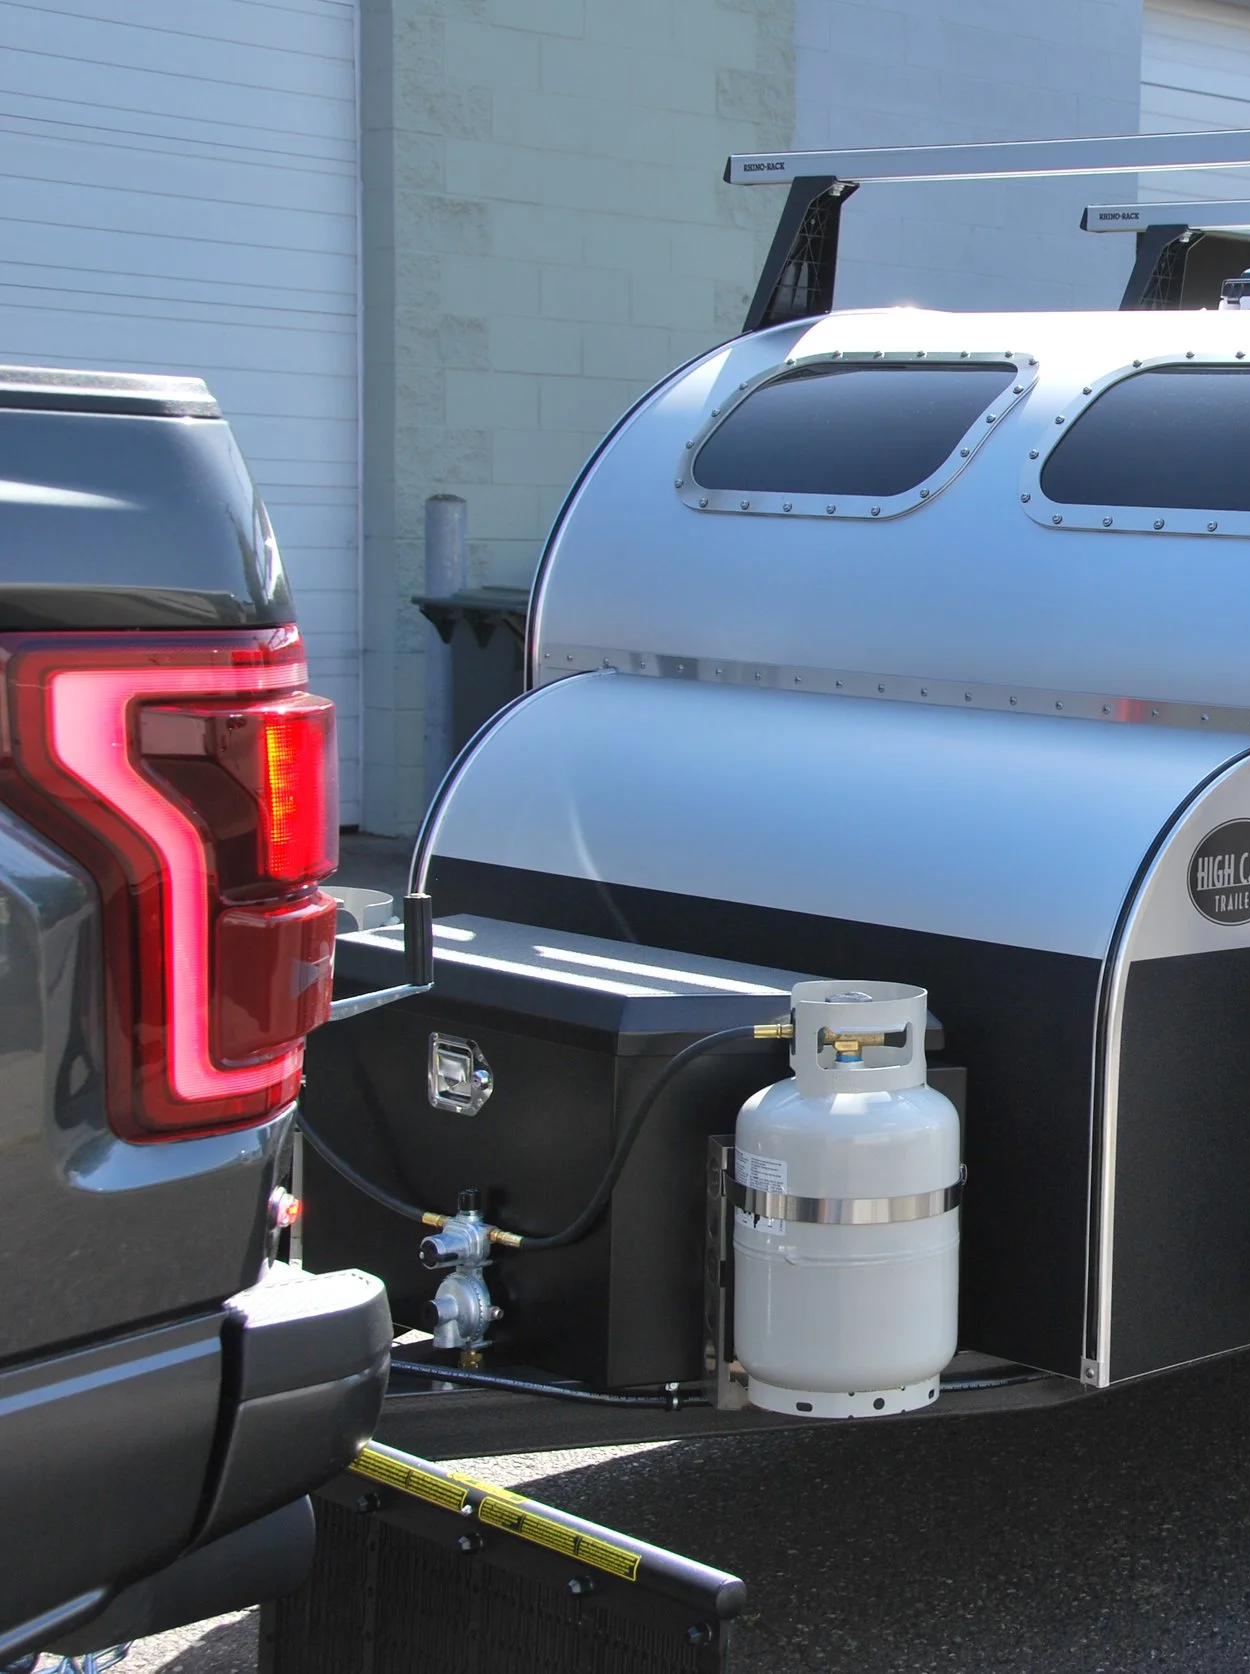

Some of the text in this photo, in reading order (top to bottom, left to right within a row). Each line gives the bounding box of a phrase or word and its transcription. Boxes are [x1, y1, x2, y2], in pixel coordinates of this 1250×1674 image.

[743, 162, 785, 172] RHINO-RACK
[1099, 212, 1140, 221] RHINO-RACK
[1196, 854, 1235, 889] HIGH
